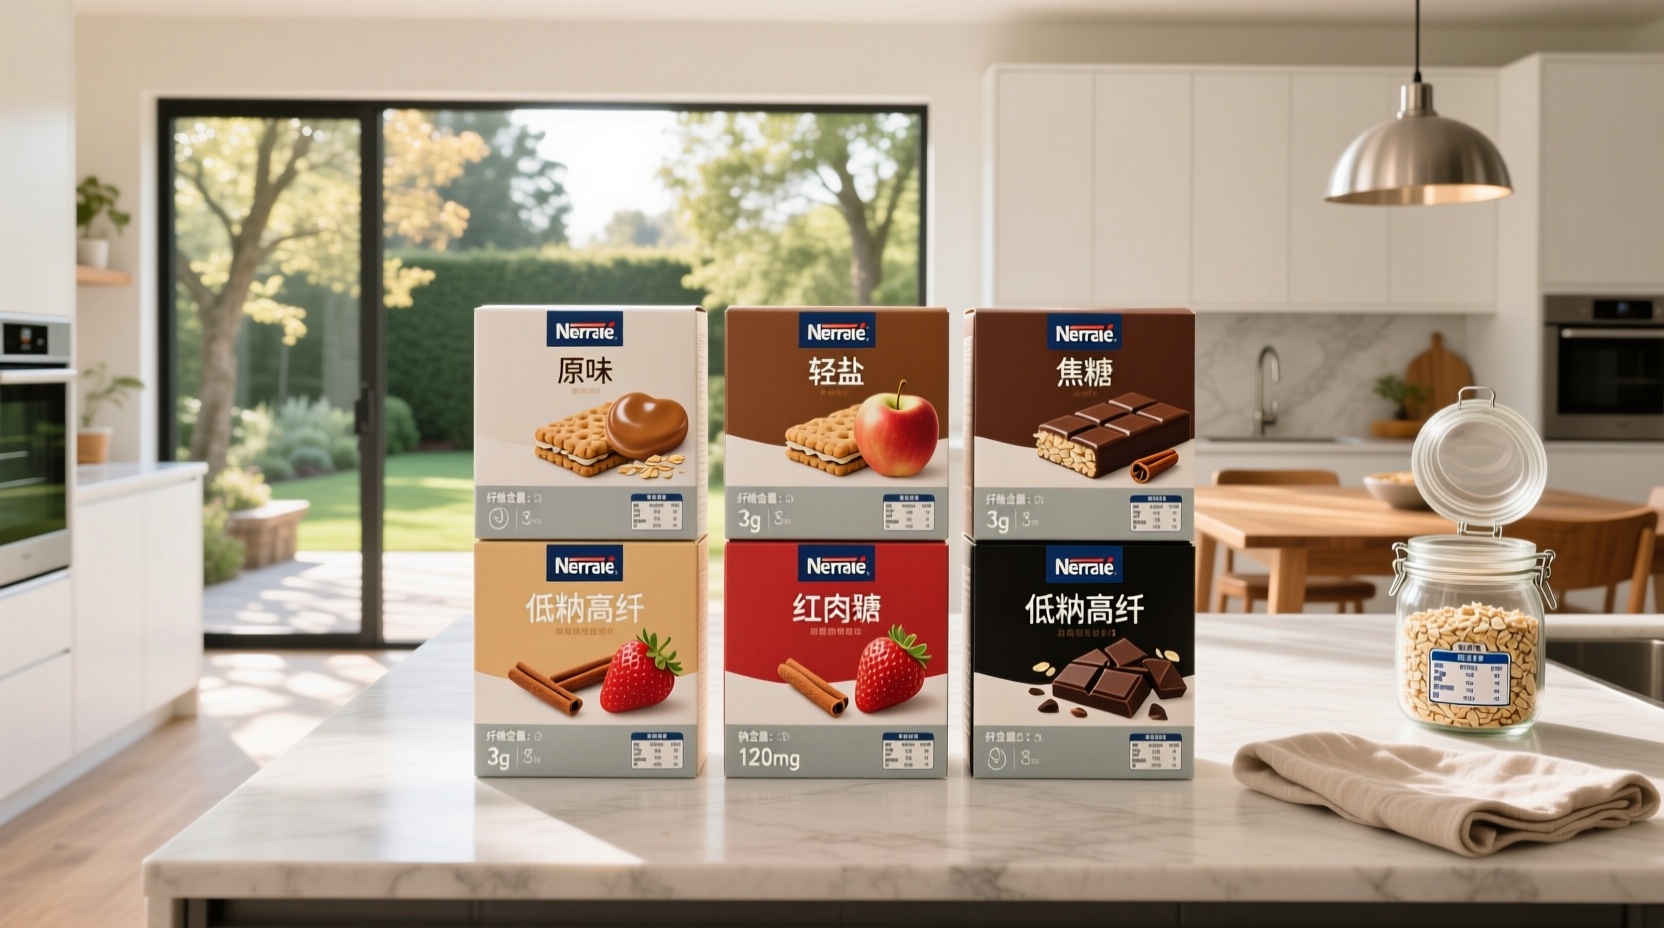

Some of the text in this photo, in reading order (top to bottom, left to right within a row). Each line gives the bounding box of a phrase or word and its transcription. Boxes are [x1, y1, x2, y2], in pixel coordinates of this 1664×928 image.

[558, 356, 612, 384] 原味
[809, 356, 864, 386] 轻盐
[1056, 357, 1113, 387] 焦糖
[738, 509, 761, 533] 3g
[987, 510, 1009, 534] 3g
[488, 747, 510, 771] 3g
[739, 747, 800, 771] 120mg
